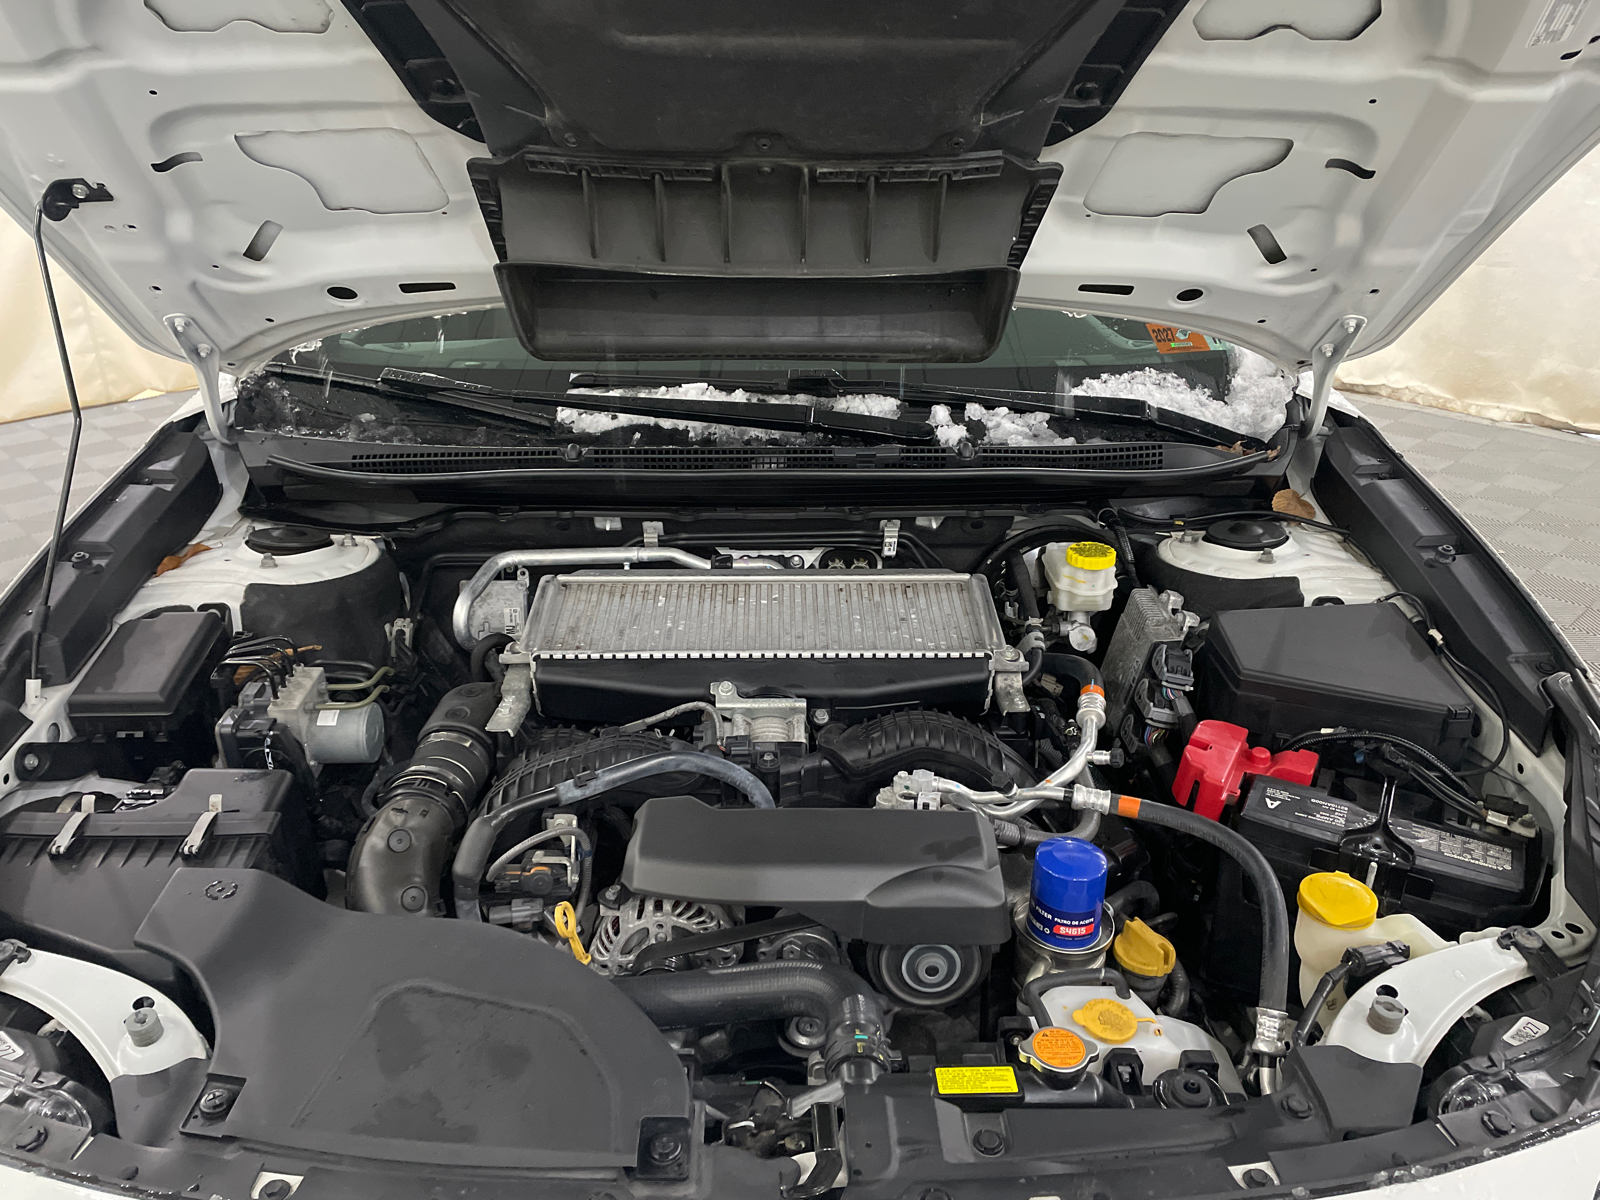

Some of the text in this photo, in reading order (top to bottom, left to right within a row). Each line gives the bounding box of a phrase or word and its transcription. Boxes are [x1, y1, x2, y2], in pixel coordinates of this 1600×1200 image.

[1152, 327, 1175, 343] 2027
[1035, 905, 1053, 920] FILTER
[1054, 917, 1071, 925] FILTRO
[1080, 917, 1094, 925] ACEITE
[1059, 926, 1086, 935] S4615
